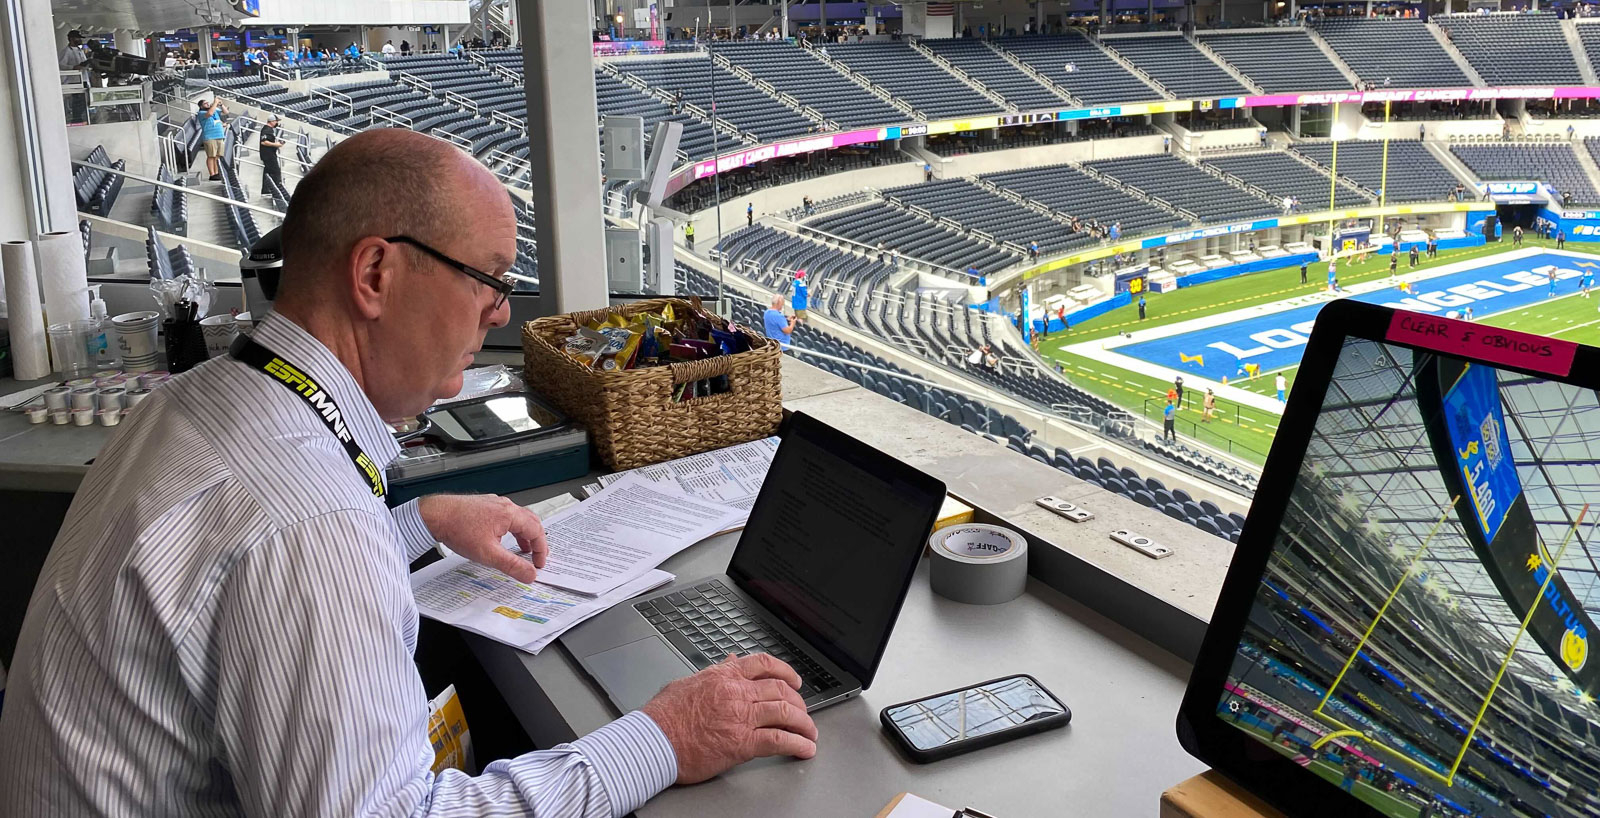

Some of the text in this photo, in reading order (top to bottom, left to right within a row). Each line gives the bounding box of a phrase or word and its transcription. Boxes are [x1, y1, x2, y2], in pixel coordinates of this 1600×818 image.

[1400, 316, 1449, 338] CLEAR
[1481, 335, 1553, 357] OBVIOUS
[263, 357, 352, 443] ESPN MNF
